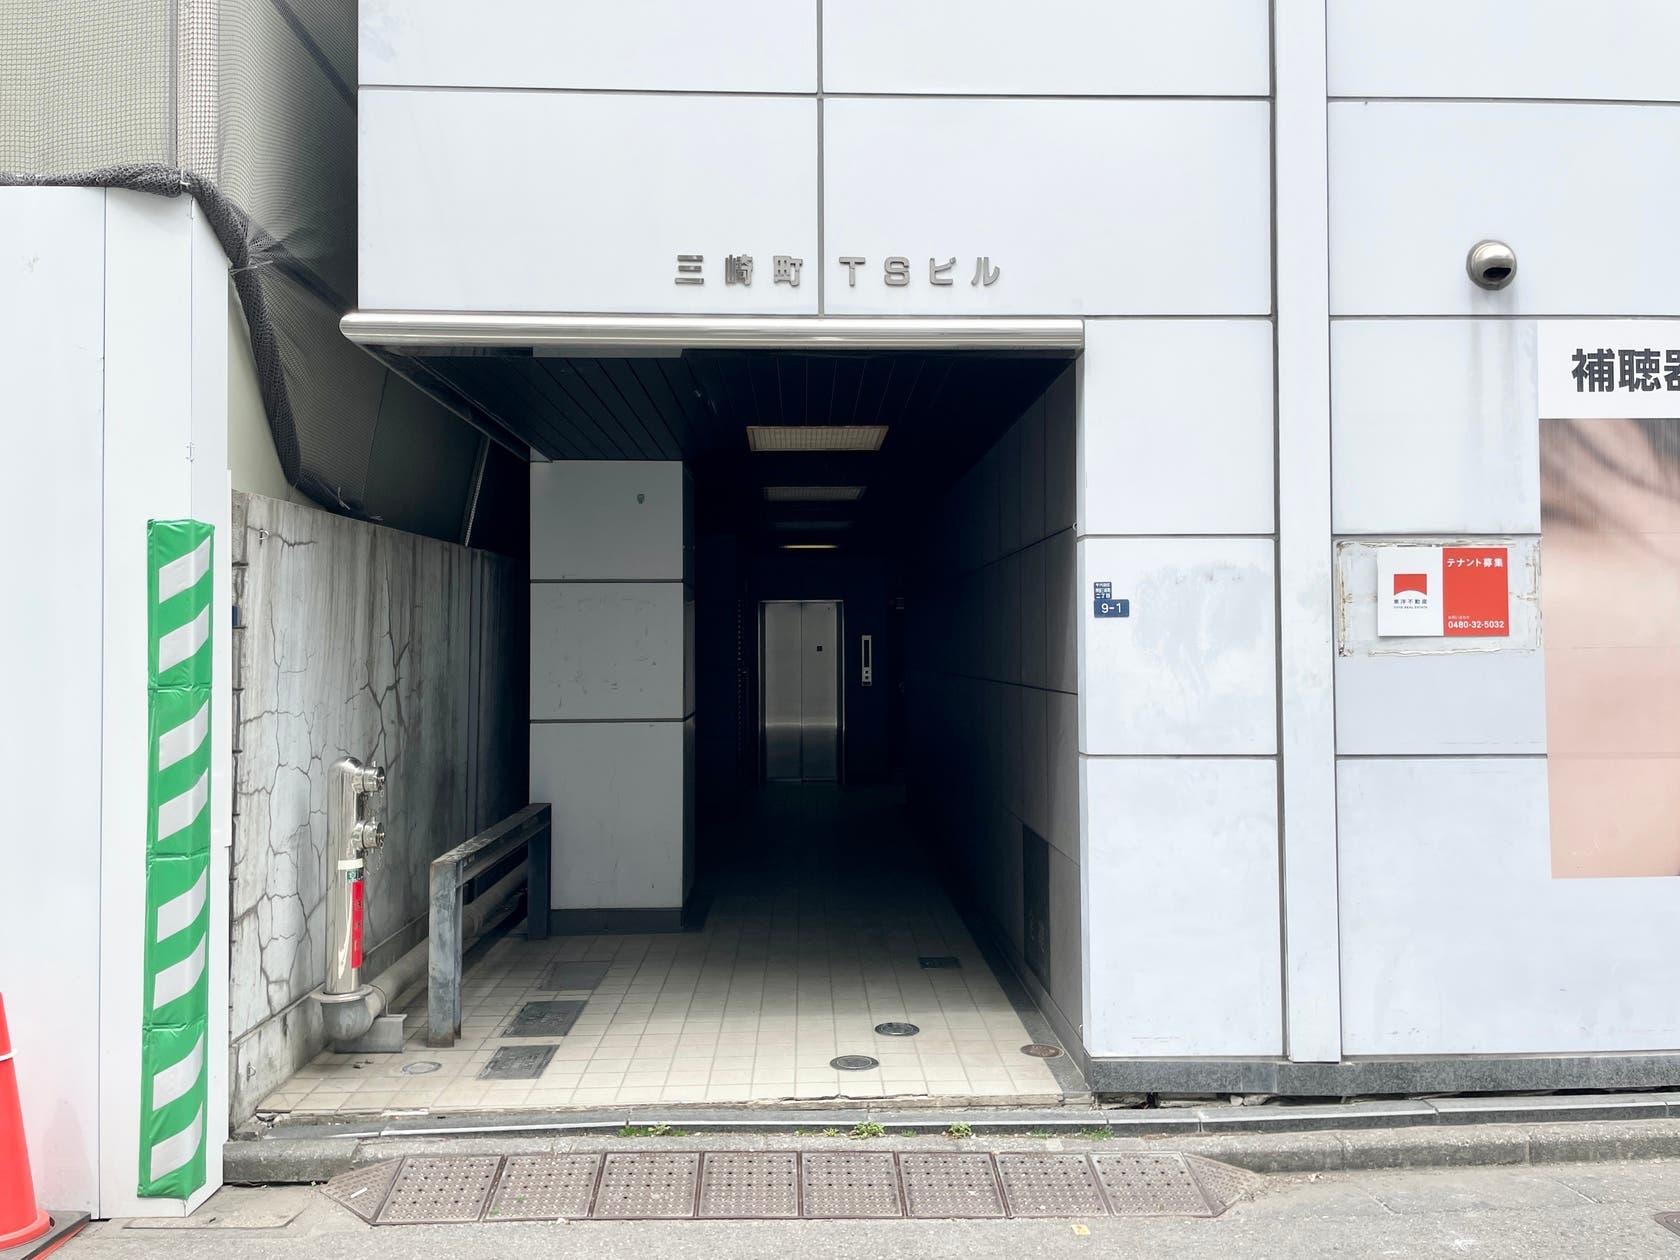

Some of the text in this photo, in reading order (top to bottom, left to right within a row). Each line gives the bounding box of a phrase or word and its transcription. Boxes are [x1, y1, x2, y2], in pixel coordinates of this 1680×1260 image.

[675, 254, 1001, 287] 三崎町 TSビル
[1447, 557, 1503, 568] テナント募集
[1101, 602, 1121, 614] 9-1
[1447, 620, 1505, 629] 0480-32-5032
